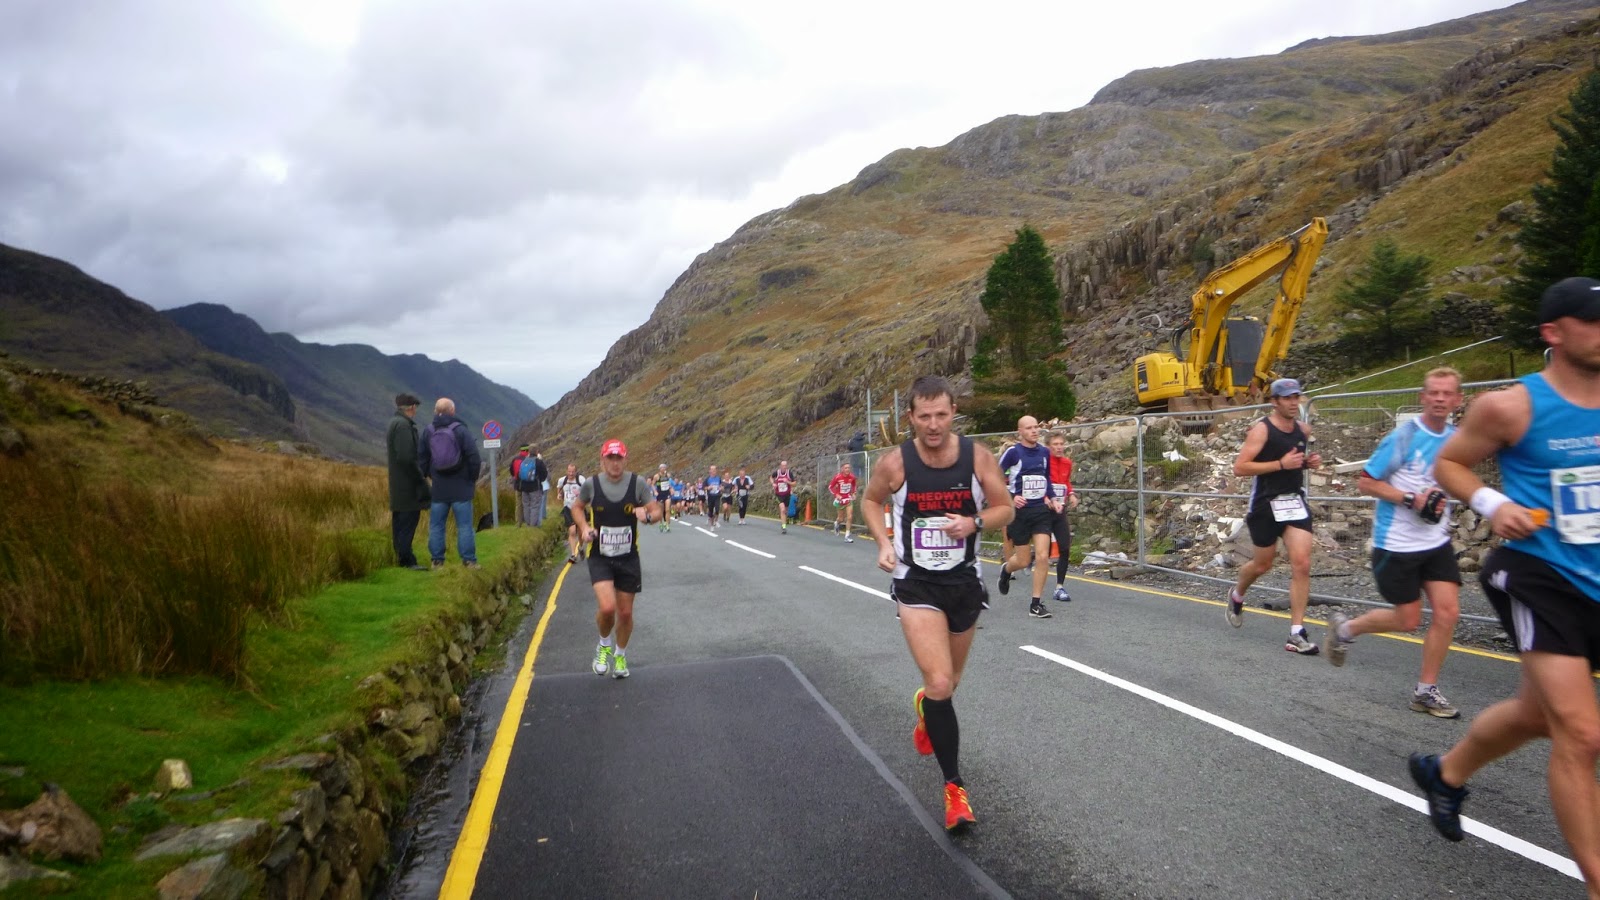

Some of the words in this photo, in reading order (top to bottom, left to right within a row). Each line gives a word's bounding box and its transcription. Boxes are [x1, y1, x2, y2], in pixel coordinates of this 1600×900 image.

[918, 500, 962, 511] EMLYN
[602, 534, 629, 544] MARK
[931, 550, 949, 558] 1586
